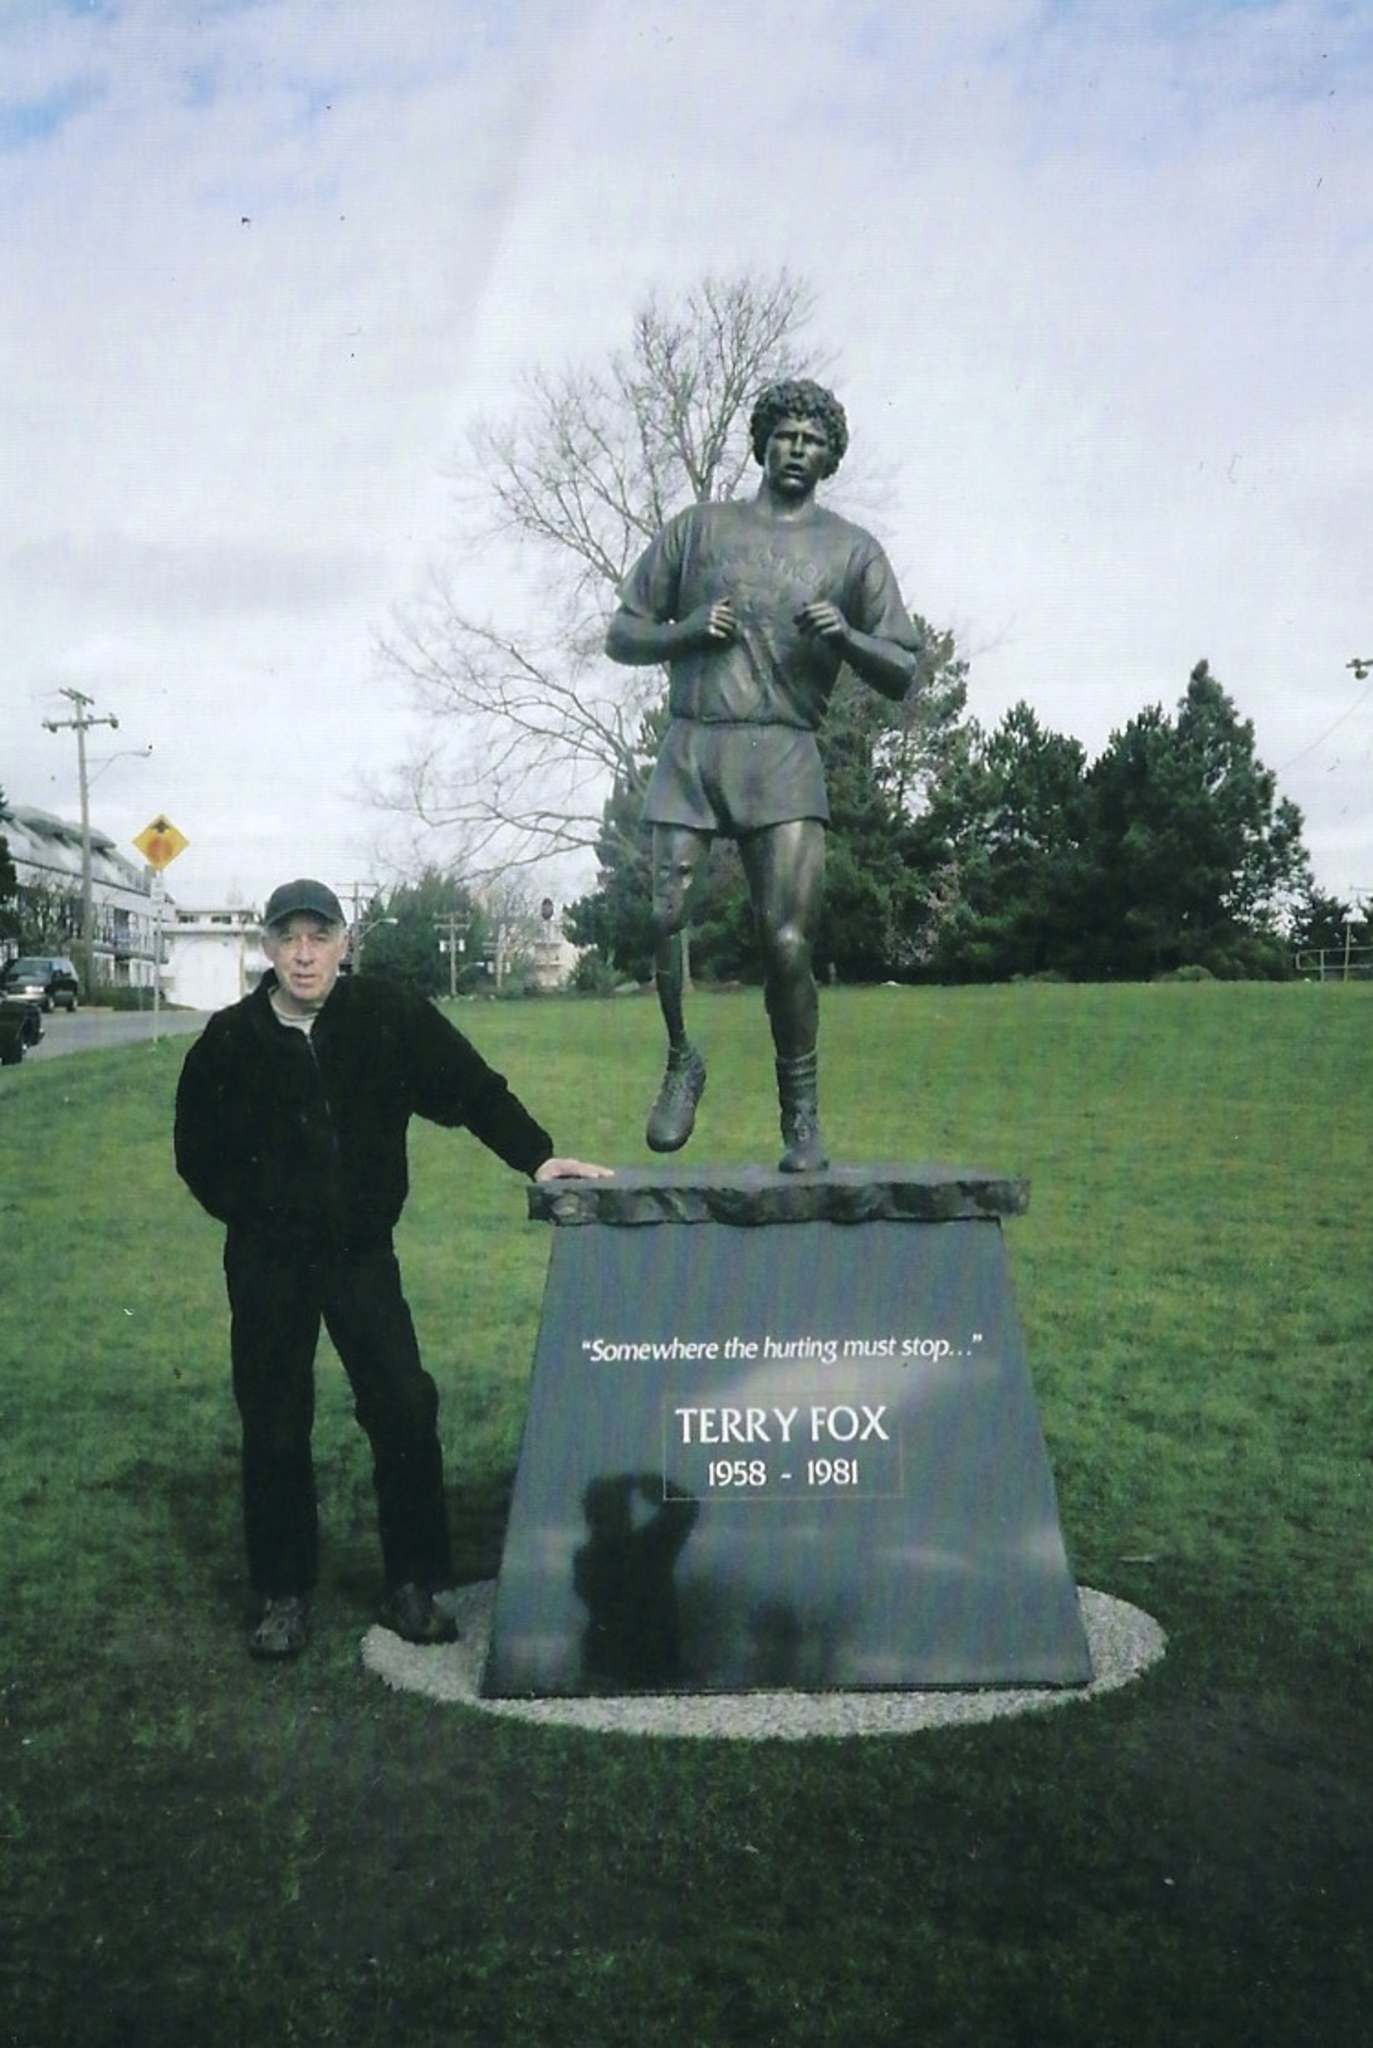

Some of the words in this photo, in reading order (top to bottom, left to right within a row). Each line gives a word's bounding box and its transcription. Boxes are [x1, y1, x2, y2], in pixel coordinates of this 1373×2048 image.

[724, 1336, 759, 1359] the
[763, 1336, 838, 1364] hurting
[843, 1337, 897, 1358] must
[674, 1407, 799, 1444] TERRY
[810, 1405, 890, 1442] FOX
[708, 1460, 767, 1487] 1958
[807, 1458, 858, 1486] 1981
